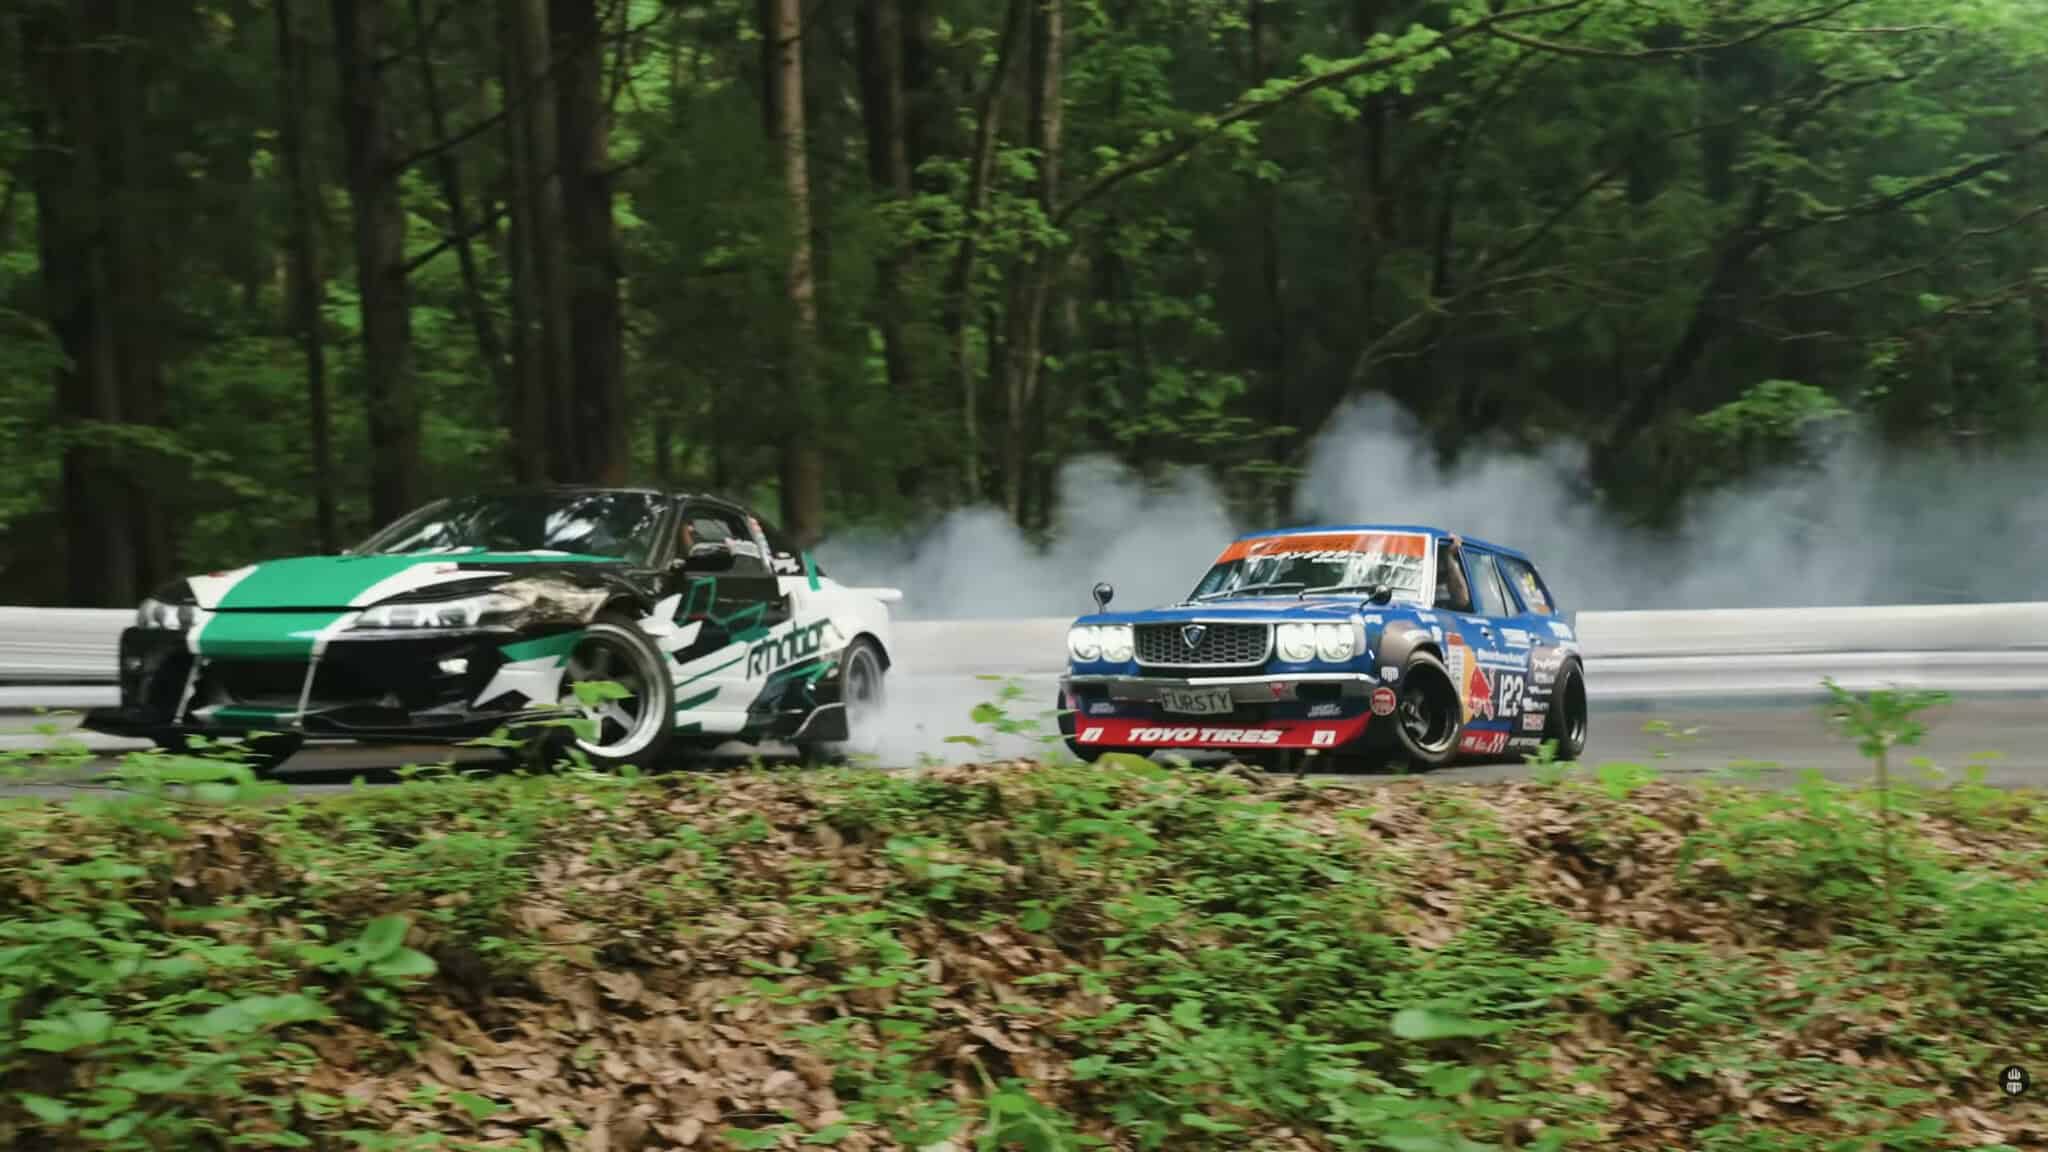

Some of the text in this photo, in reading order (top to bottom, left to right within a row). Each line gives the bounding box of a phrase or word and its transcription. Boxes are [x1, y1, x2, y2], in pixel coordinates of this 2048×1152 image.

[1160, 690, 1231, 712] FURSTY
[1127, 727, 1283, 744] TOYO TIRES
